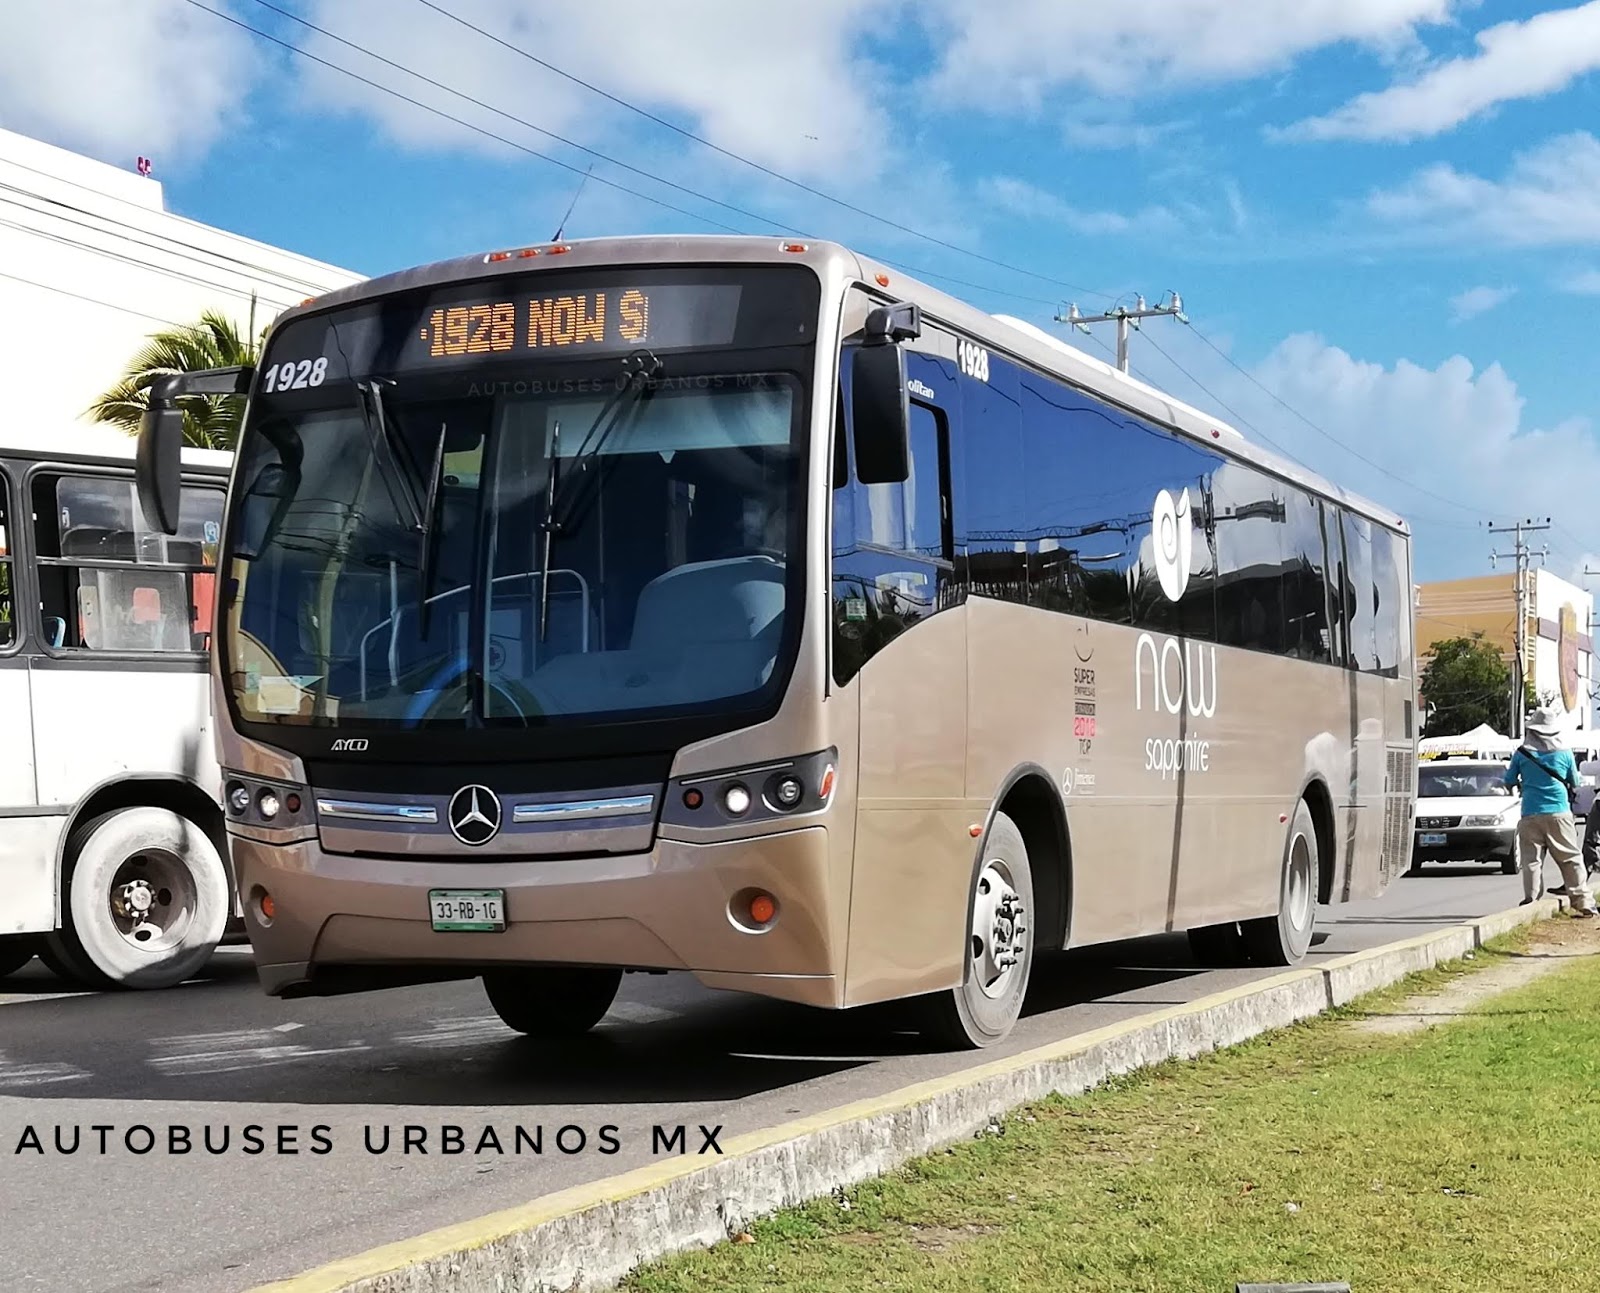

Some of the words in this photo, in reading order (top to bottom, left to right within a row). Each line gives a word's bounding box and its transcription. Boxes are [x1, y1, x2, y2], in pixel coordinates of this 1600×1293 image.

[527, 293, 605, 348] NOW
[265, 356, 329, 393] 1928
[958, 340, 990, 382] 1928
[907, 380, 934, 399] olitan
[1074, 667, 1095, 684] SUPER
[330, 738, 369, 751] AYCO
[1145, 731, 1210, 780] sapphire
[436, 901, 497, 919] 33-RB-1G
